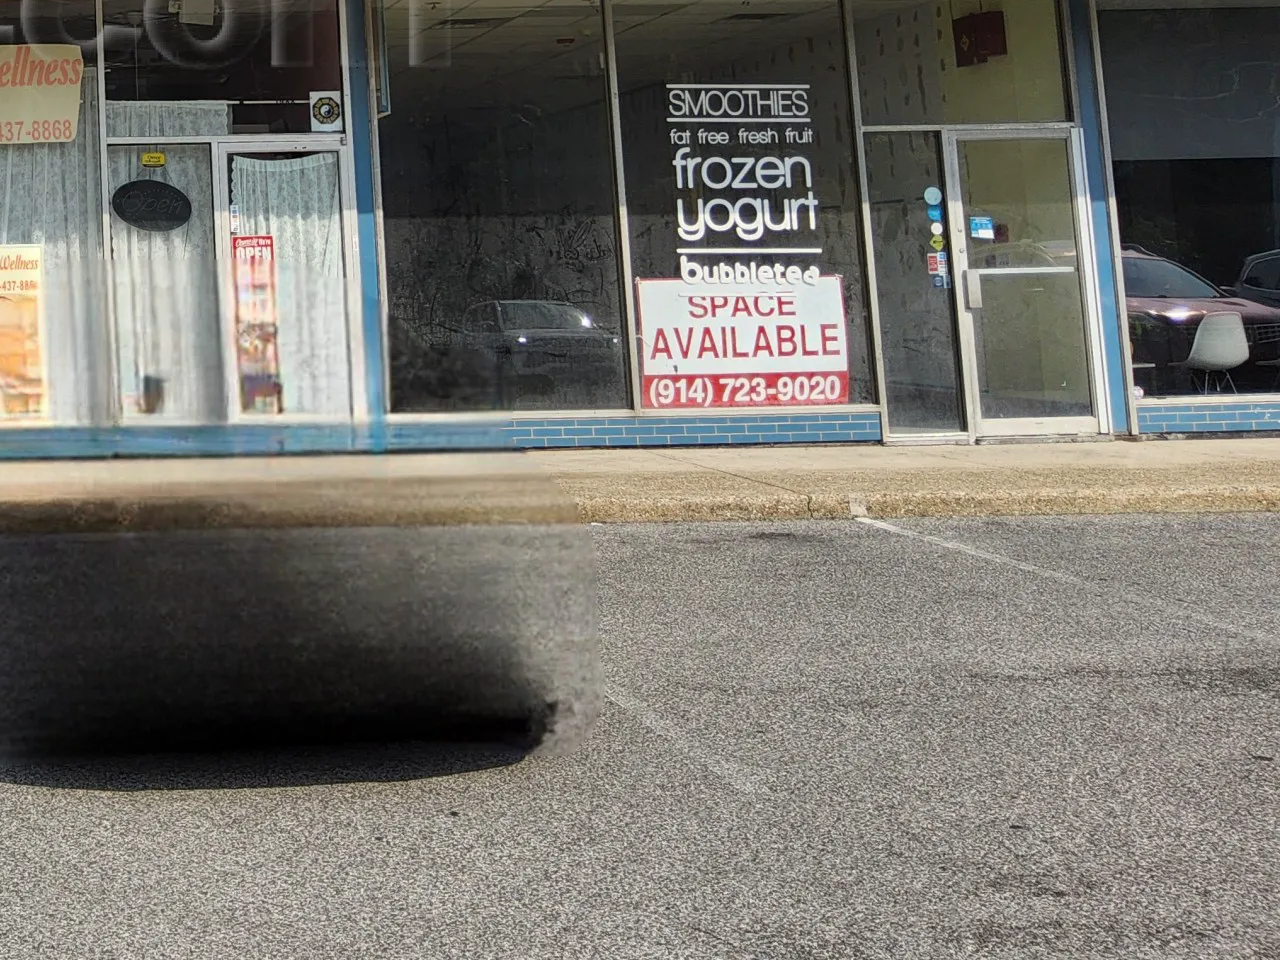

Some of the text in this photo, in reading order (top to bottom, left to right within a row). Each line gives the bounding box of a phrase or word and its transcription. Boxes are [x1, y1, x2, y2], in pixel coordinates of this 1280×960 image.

[669, 90, 809, 117] SMOOTHIES
[670, 127, 813, 144] fat free fresh fruit
[672, 147, 812, 189] frozen
[676, 191, 819, 241] yogurt
[0, 255, 38, 271] Wellness
[680, 255, 820, 286] bubbletea
[688, 292, 796, 319] SPACE
[650, 323, 841, 360] AVAILABLE
[649, 375, 841, 408] (914) 723-9020
